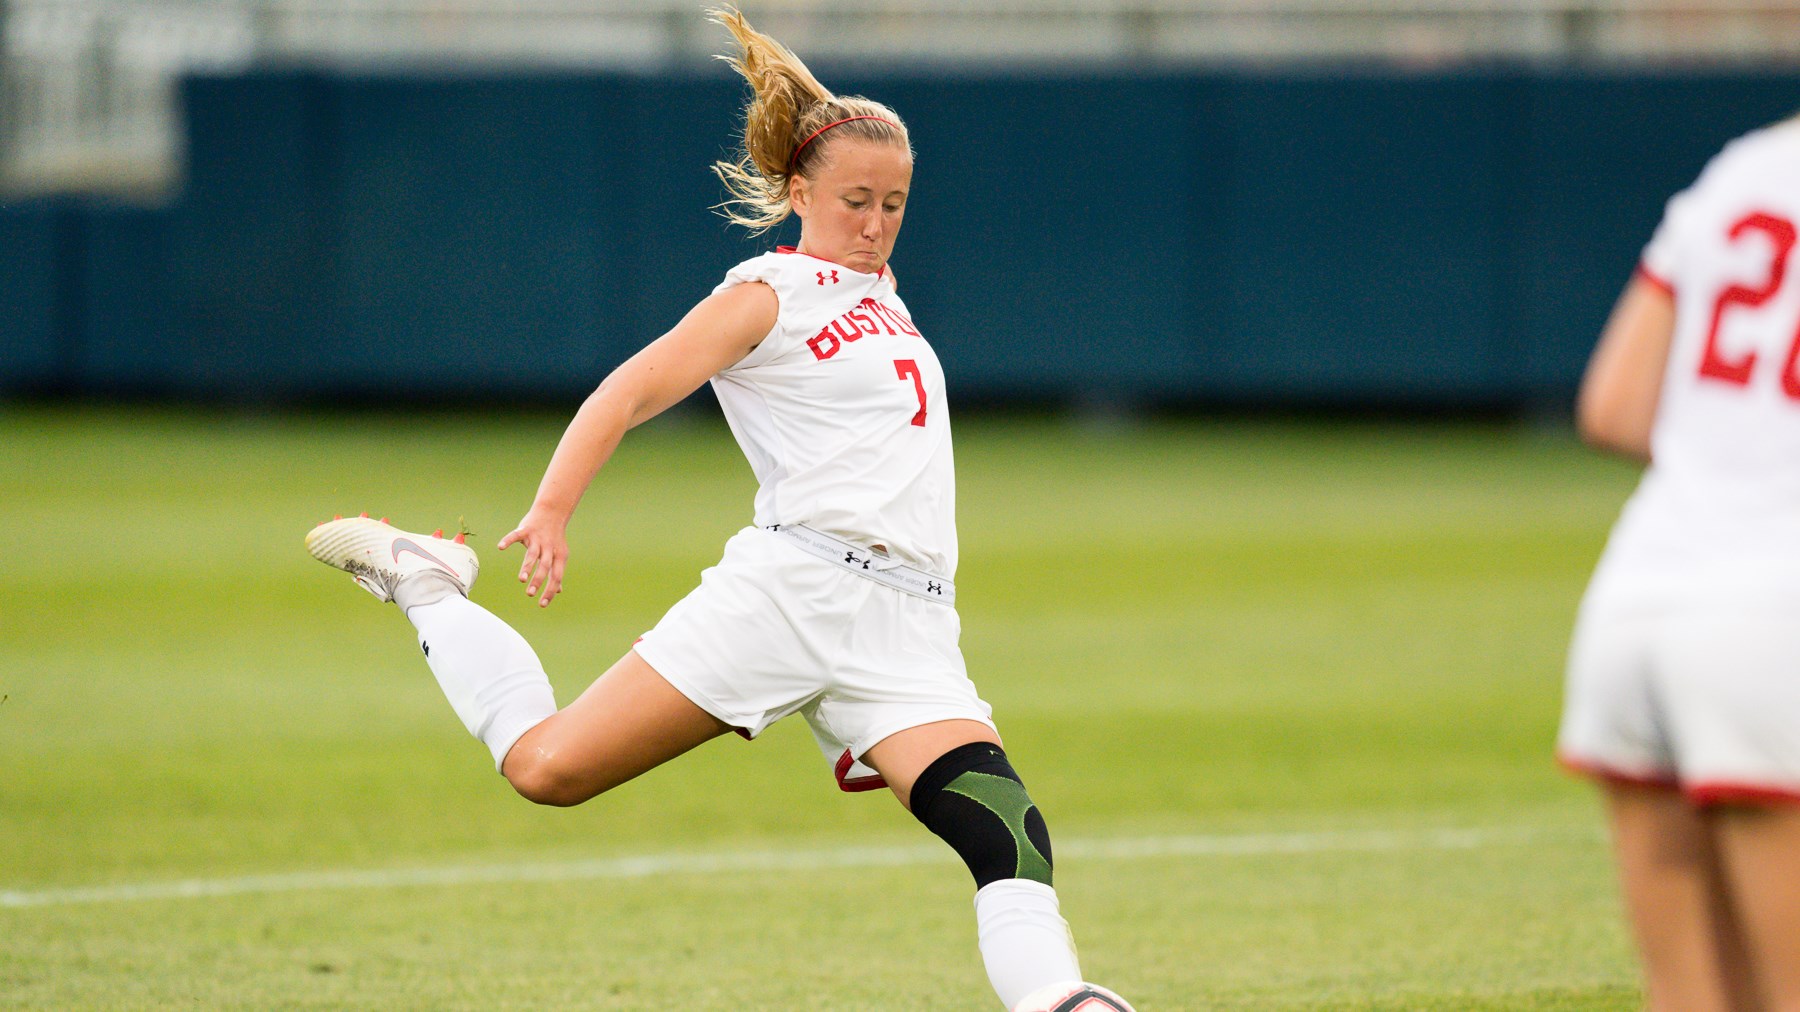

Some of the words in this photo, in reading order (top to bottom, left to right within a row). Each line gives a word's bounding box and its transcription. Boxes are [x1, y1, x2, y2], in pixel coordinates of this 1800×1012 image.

[806, 298, 921, 361] BOSTO
[1698, 212, 1800, 399] 2
[893, 359, 927, 427] 7
